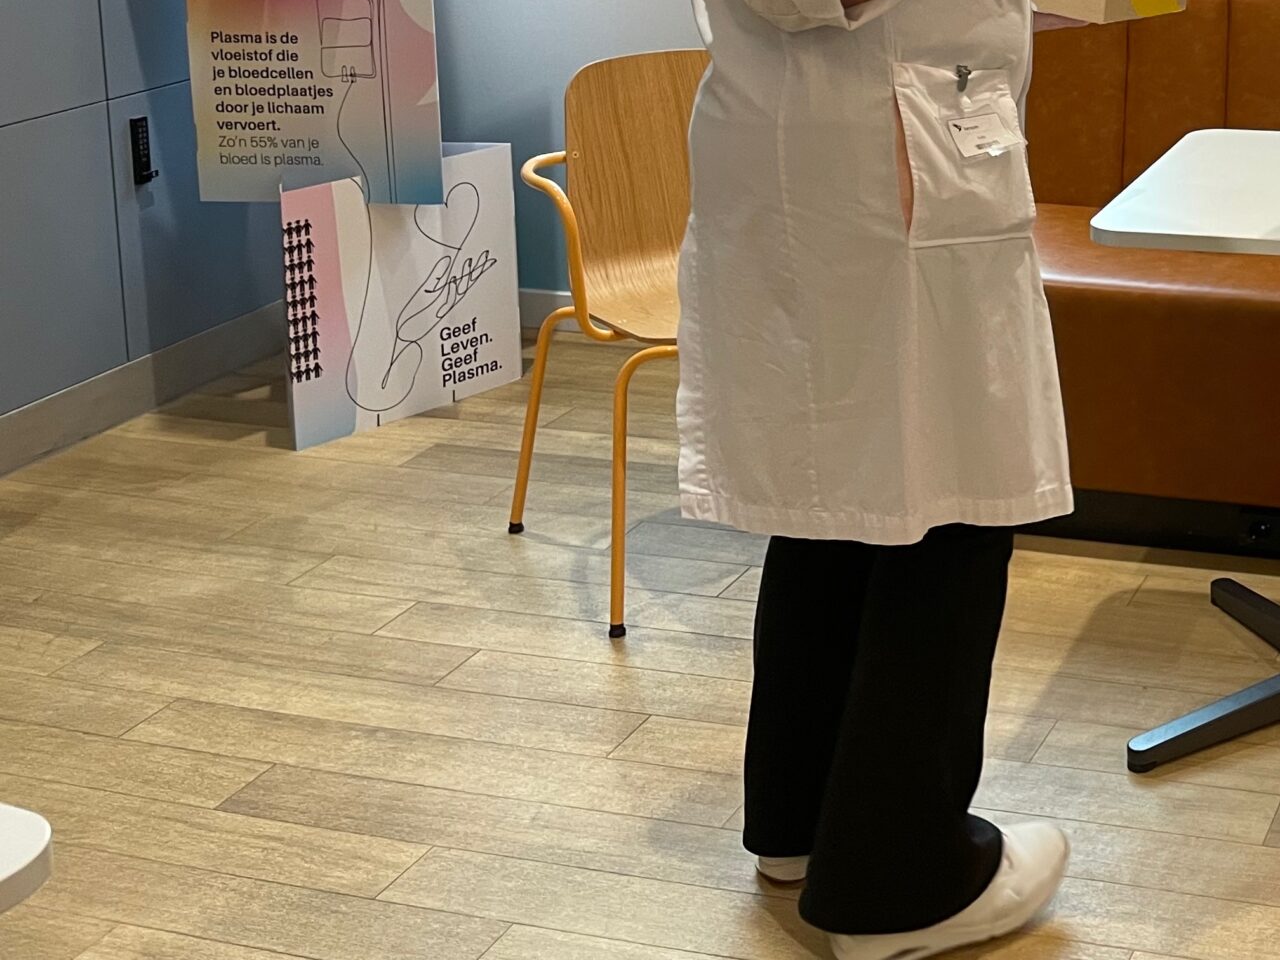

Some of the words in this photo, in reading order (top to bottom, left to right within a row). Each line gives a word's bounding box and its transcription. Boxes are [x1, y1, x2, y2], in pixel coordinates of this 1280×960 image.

[210, 31, 262, 44] Plasma
[265, 31, 276, 44] is
[280, 31, 299, 44] de
[211, 48, 273, 61] vloeistof
[276, 49, 299, 61] die
[212, 66, 225, 81] je
[228, 66, 314, 79] bloedcellen
[214, 86, 232, 96] en
[235, 84, 333, 99] bloedplaatjes
[215, 101, 248, 114] door
[251, 102, 265, 116] je
[267, 101, 325, 114] lichaam
[216, 119, 281, 131] vervoert.
[218, 135, 247, 148] Zo'n
[250, 136, 278, 149] 55%
[280, 138, 305, 149] van
[307, 137, 320, 151] je
[219, 153, 258, 165] bloed
[260, 153, 271, 165] is
[274, 153, 325, 167] plasma.
[440, 317, 477, 341] Geef
[440, 333, 493, 357] Leven.
[441, 347, 479, 372] Geef
[442, 360, 503, 388] Plasma.
